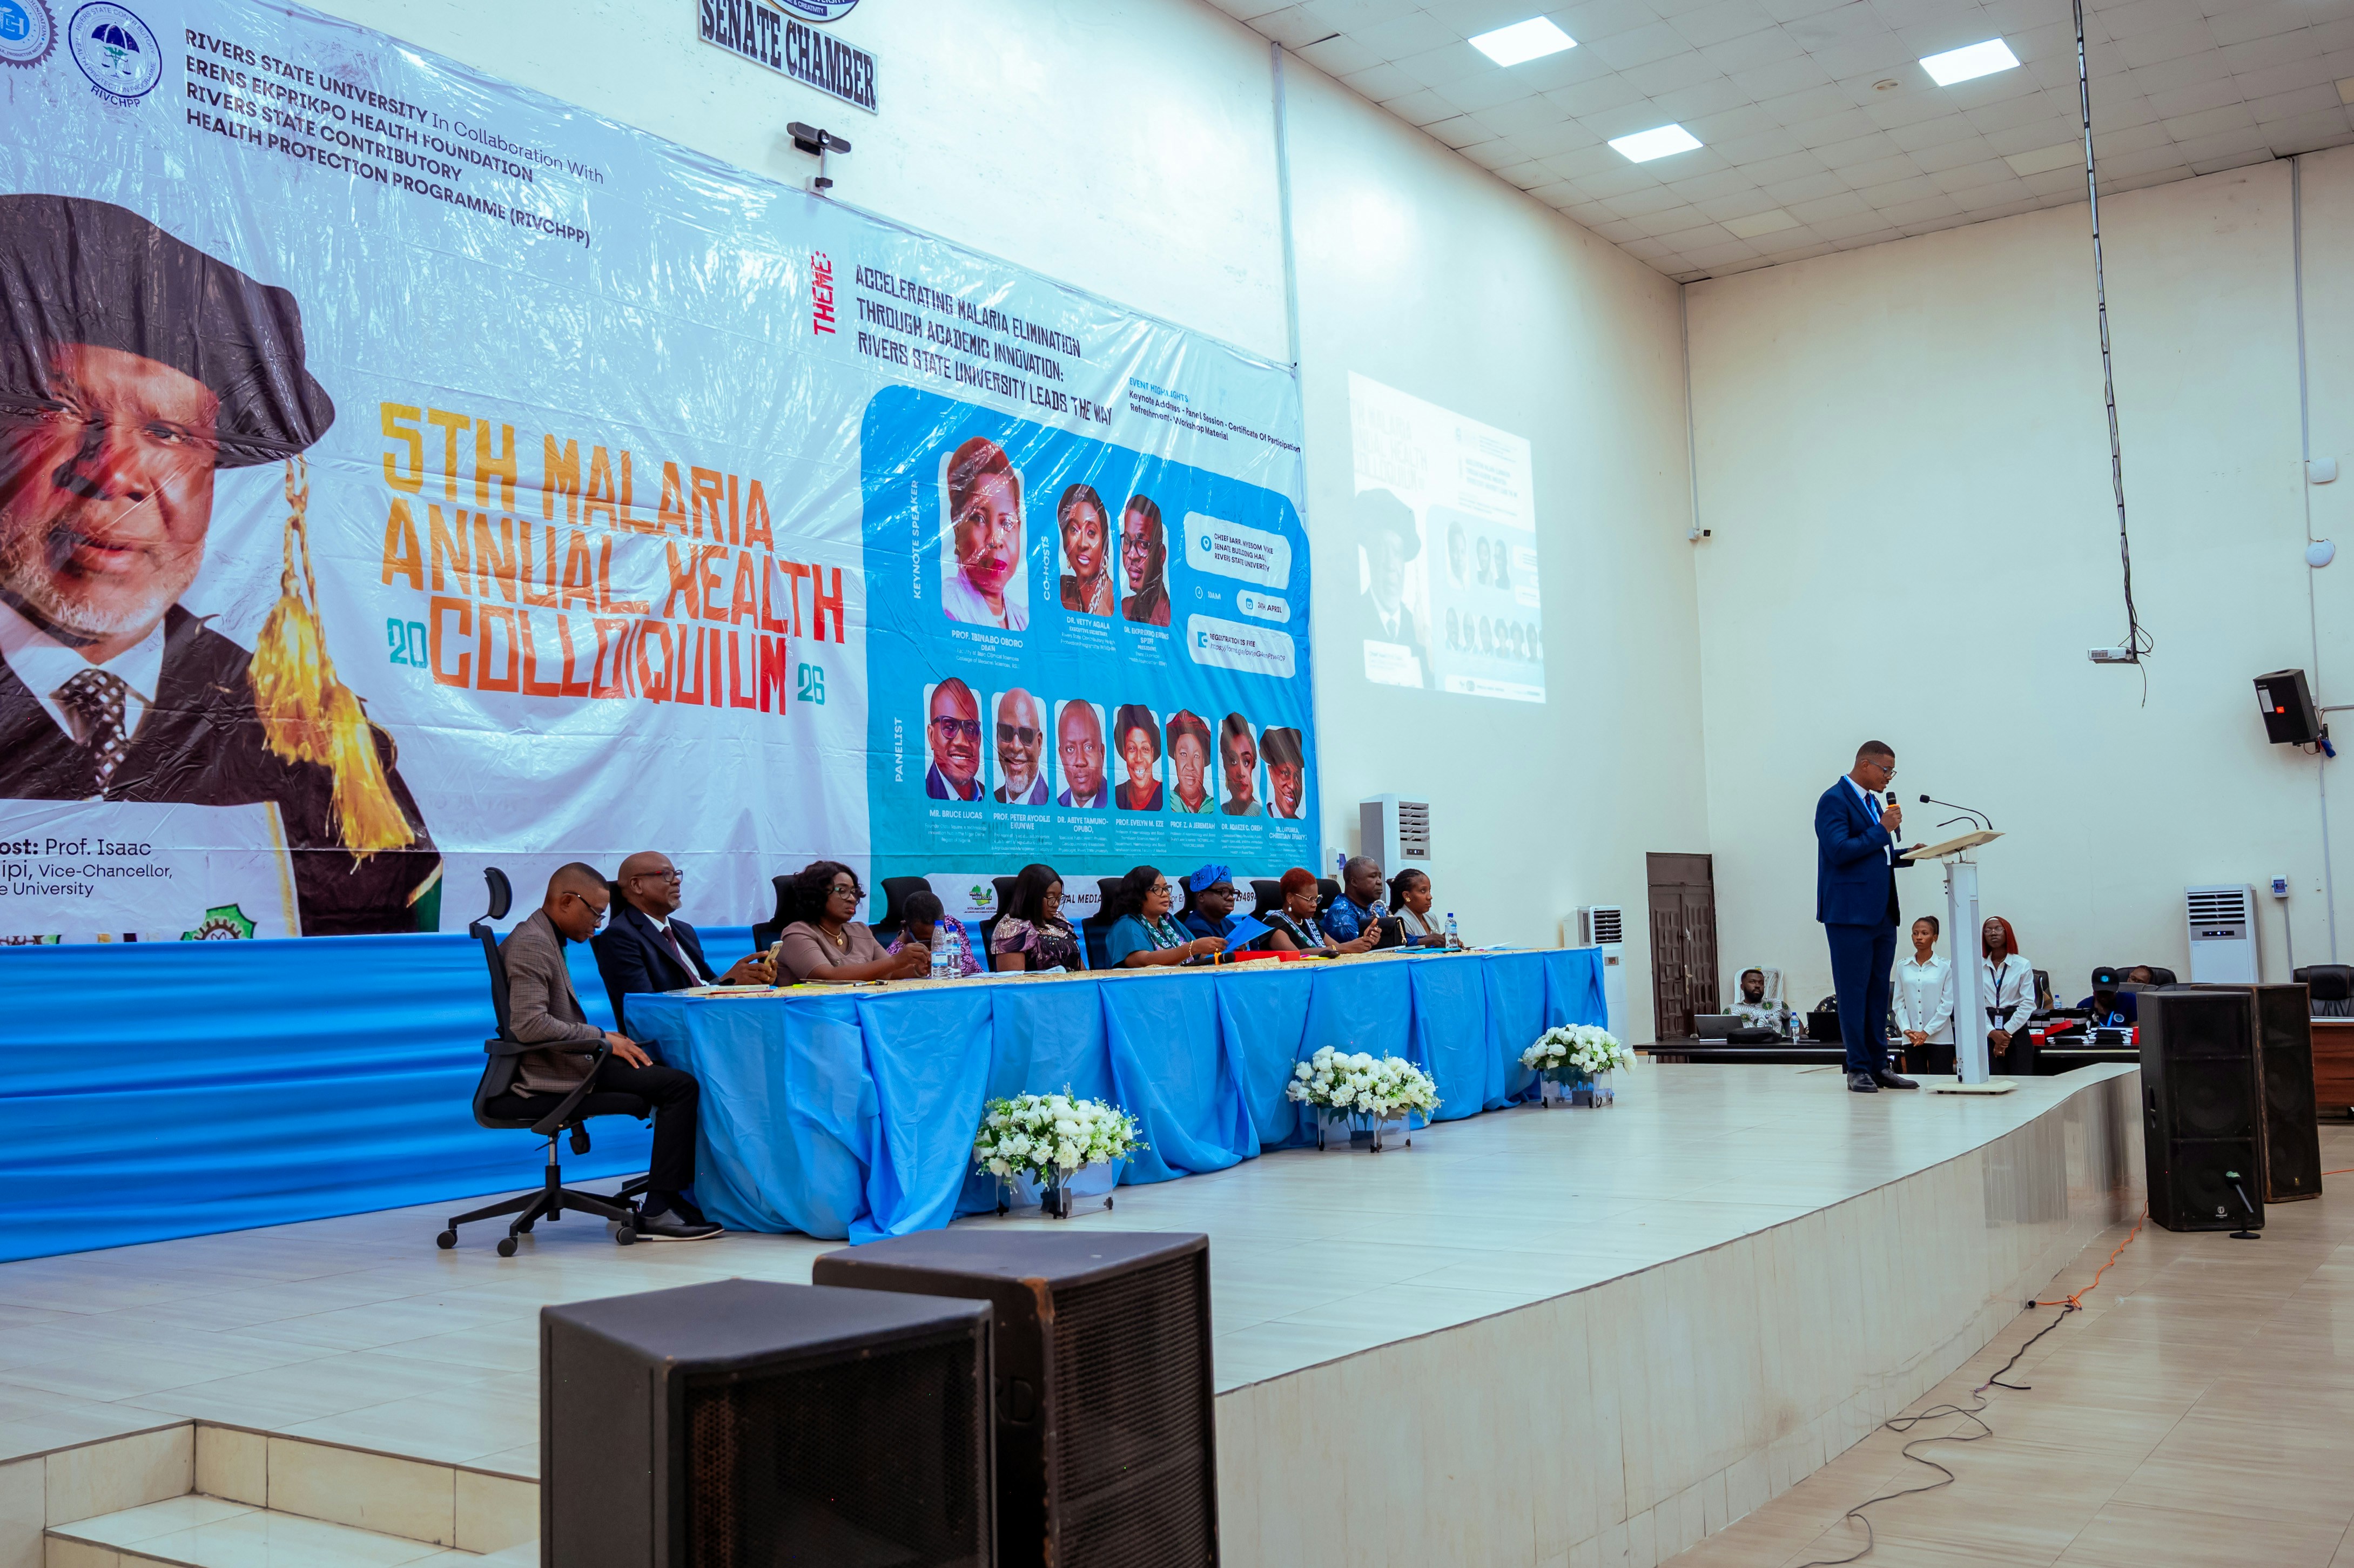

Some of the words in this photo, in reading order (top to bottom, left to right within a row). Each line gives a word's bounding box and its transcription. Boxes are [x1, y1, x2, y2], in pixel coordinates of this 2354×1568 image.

[75, 11, 91, 32] RIVERS
[92, 7, 111, 18] STATE
[113, 9, 155, 54] CONTRIBUTORY
[798, 1, 824, 14] CREATIVITY
[75, 37, 88, 71] HEALTH
[87, 66, 130, 93] PROTECTION
[130, 61, 156, 93] PROGRAMME
[702, 0, 782, 70] SENATE
[786, 19, 876, 110] CHAMBER
[91, 85, 140, 107] RIVCHPP
[185, 28, 255, 66] RIVERS
[261, 55, 314, 86] STATE
[319, 74, 429, 124] UNIVERSITY
[432, 112, 449, 132] In
[454, 122, 563, 171] Collaboration
[567, 159, 604, 185] With
[186, 55, 247, 89] ERENS
[252, 77, 346, 120] EKPRIKPO
[352, 110, 418, 145] HEALTH
[423, 133, 533, 183] FOUNDATION
[187, 82, 257, 117] RIVERS
[262, 106, 315, 137] STATE
[320, 126, 462, 182] CONTRIBUTORY
[187, 108, 262, 145] HEALTH
[268, 132, 388, 184] PROTECTION
[393, 172, 506, 220] PROGRAMME
[510, 208, 590, 248] (RIVCHPP)
[811, 250, 836, 335] THEME:
[856, 264, 953, 315] ACCELERATING
[958, 298, 1009, 333] MALARIA
[1013, 318, 1081, 358] ELIMINATION
[857, 297, 923, 339] THROUGH
[927, 325, 990, 359] ACADEMIC
[994, 342, 1064, 382] INNOVATION:
[858, 331, 909, 366] RIVERS
[912, 348, 952, 379] STATE
[956, 361, 1026, 401] UNIVERSITY
[1030, 382, 1068, 414] LEADS
[1071, 396, 1091, 421] THE
[1094, 402, 1112, 426] WAY
[1129, 377, 1148, 391] EVENT
[1129, 390, 1154, 406] Keynote
[1155, 400, 1180, 413] Address
[1186, 409, 1202, 420] Panel
[1203, 413, 1223, 427] Session
[1228, 422, 1258, 439] Certificate
[1260, 433, 1267, 441] Of
[1268, 435, 1301, 454] Participation
[1130, 403, 1169, 421] Refreshment
[1173, 416, 1204, 434] Workshop
[1205, 427, 1229, 441] Material
[380, 401, 518, 513] 5TH
[543, 434, 774, 553] MALARIA
[910, 479, 919, 529] SPEAKER
[913, 531, 922, 600] KEYNOTE
[1214, 533, 1228, 541] CHIEF
[1242, 541, 1262, 551] NYESOM
[1215, 543, 1230, 553] SENATE
[1232, 547, 1253, 558] BUILDING
[1215, 553, 1230, 562] RIVERS
[1232, 557, 1243, 566] STATE
[1245, 560, 1269, 572] UNIVERSITY
[381, 497, 649, 615] ANNUAL
[663, 542, 845, 644] HEALTH
[1041, 535, 1050, 601] CO-HOSTS
[1076, 618, 1092, 627] VETTY
[1093, 621, 1110, 630] AGALA
[1208, 591, 1221, 600] 10AM
[1267, 604, 1282, 613] APRIL
[388, 617, 428, 670] 20
[431, 596, 786, 716] COLLOQUIUM
[797, 662, 825, 705] 26
[952, 630, 970, 640] PROF.
[971, 632, 999, 644] IBINABO
[1000, 637, 1023, 648] OBORO
[894, 717, 903, 783] PANELIST
[942, 810, 961, 818] BRUCE
[963, 811, 983, 819] LUCAS
[993, 812, 1009, 820] PROF.
[1011, 822, 1034, 830] EKUNWE
[1073, 825, 1094, 833] OPUBO,
[45, 838, 91, 856] Prof.
[97, 839, 152, 856] Isaac
[14, 881, 94, 897] University
[38, 864, 173, 879] Vice-Chancellor,
[1078, 894, 1101, 903] MEDIA
